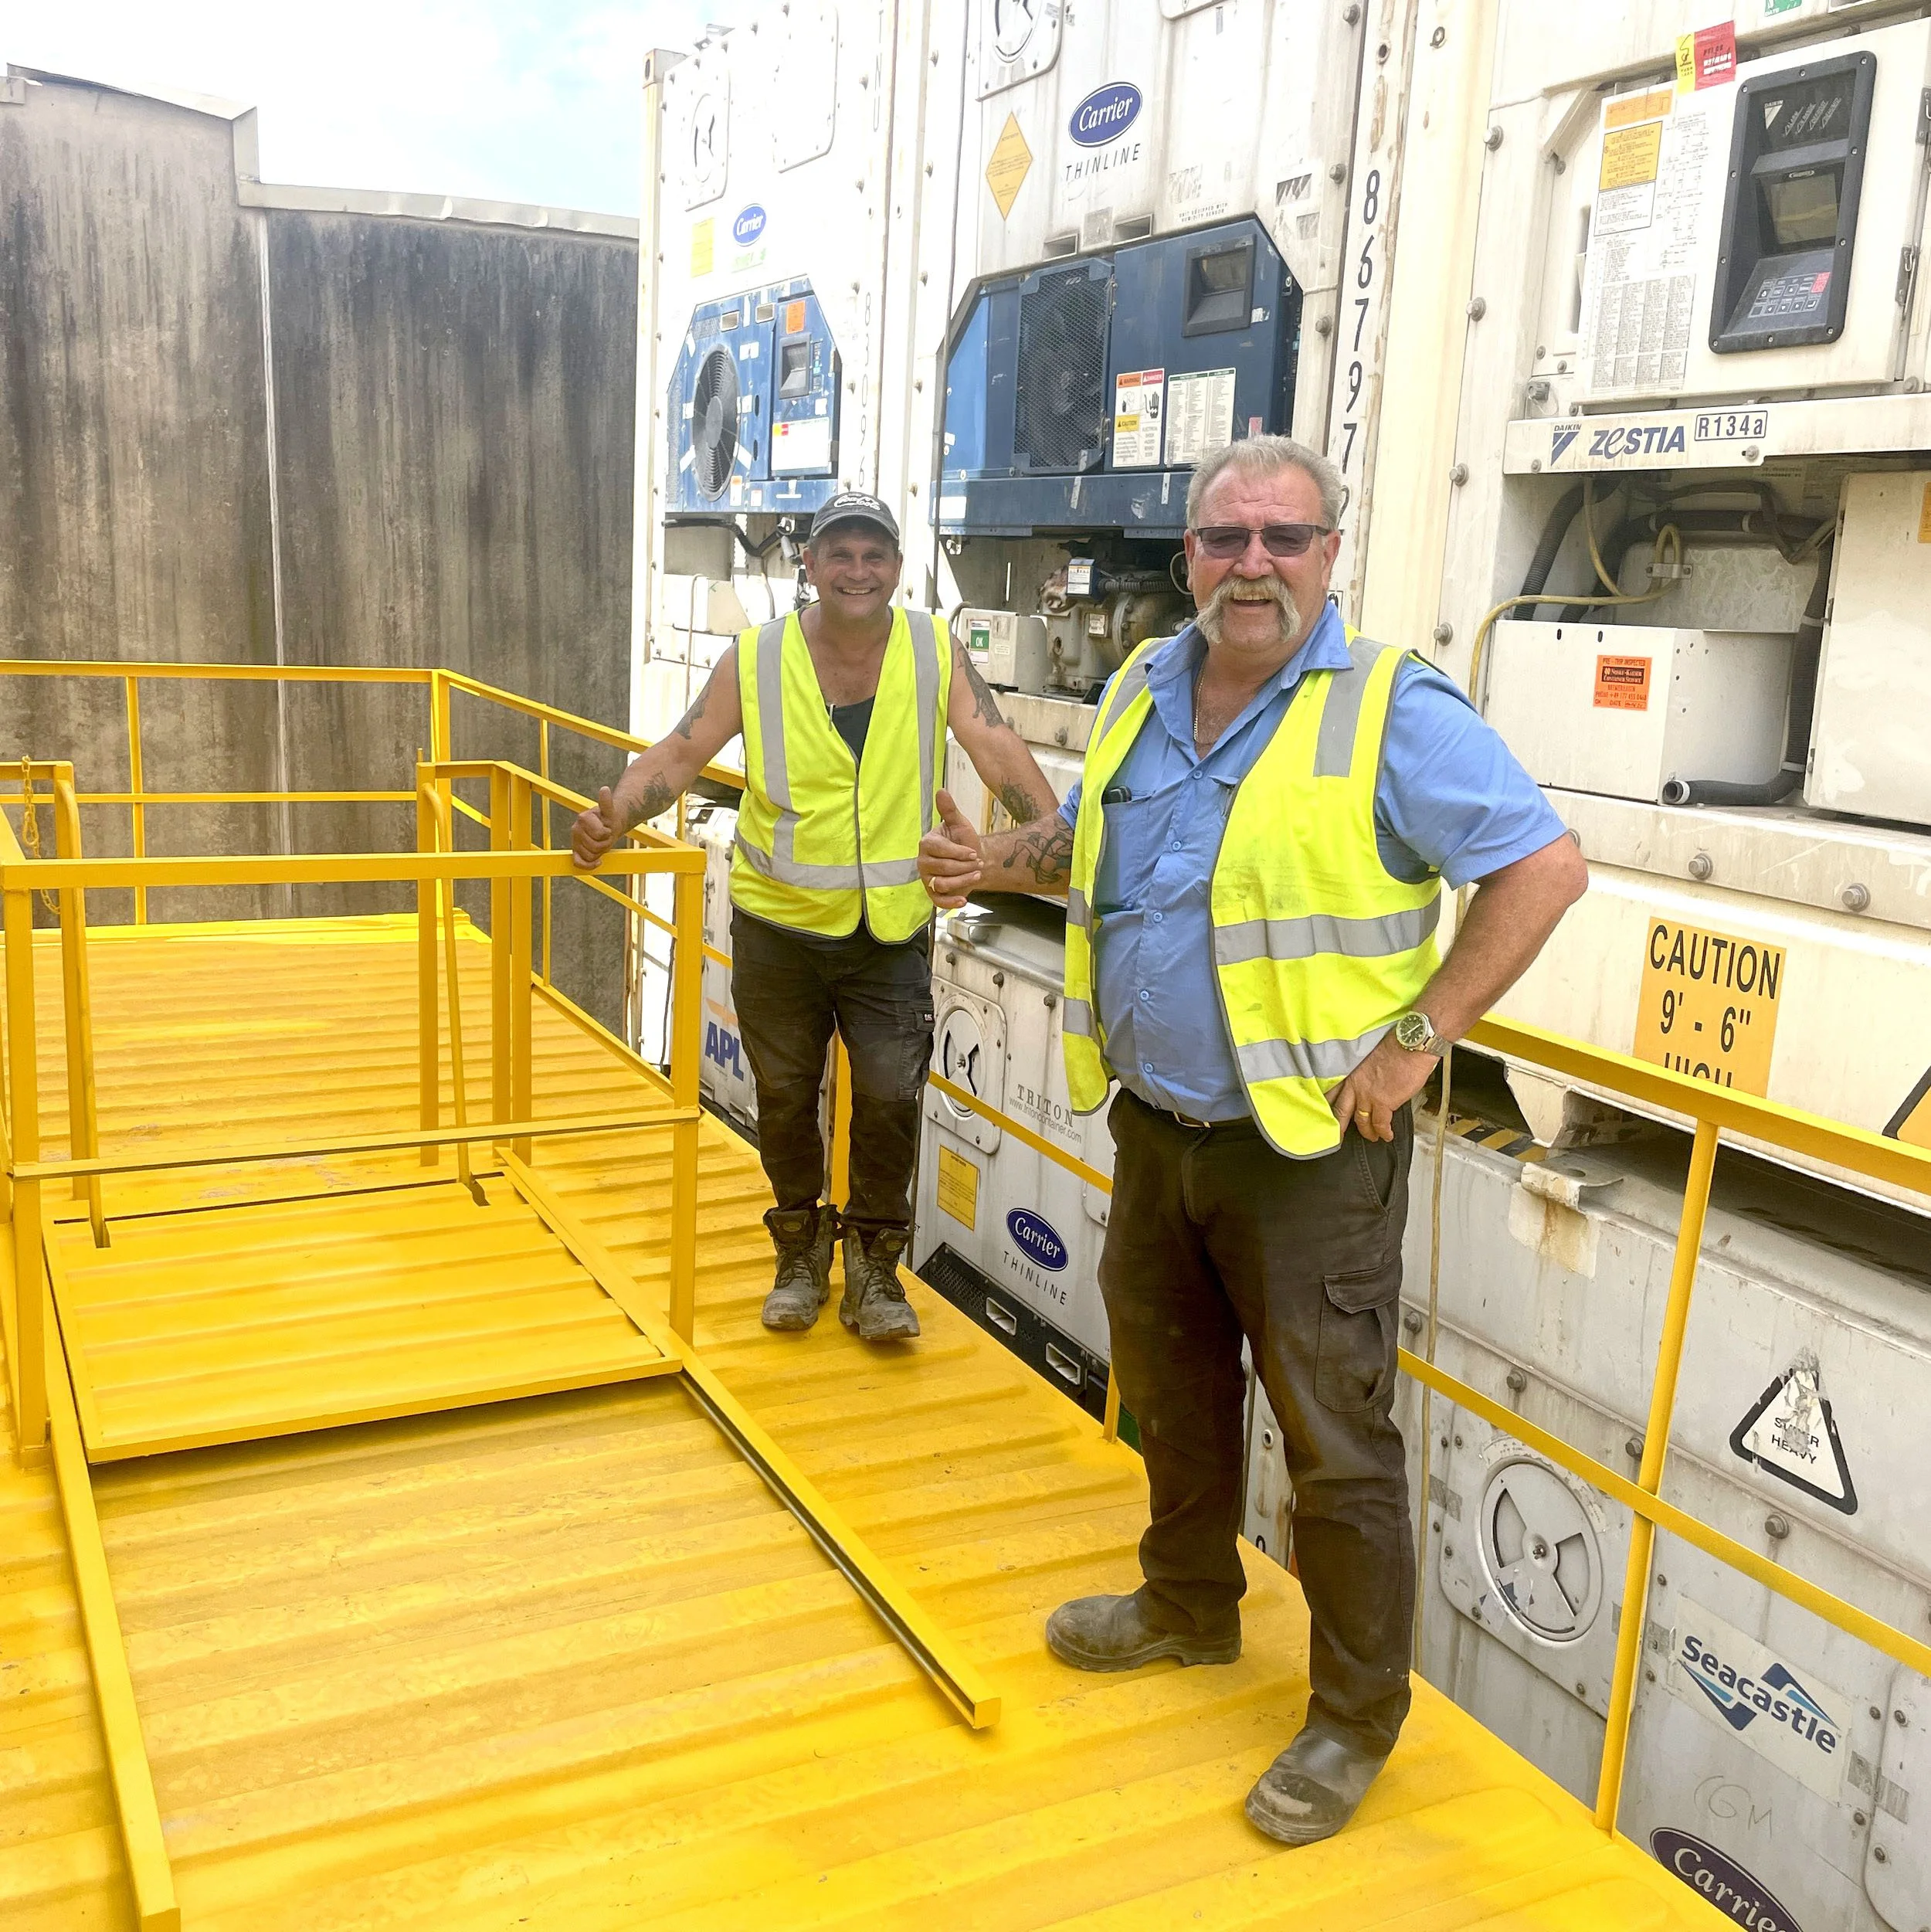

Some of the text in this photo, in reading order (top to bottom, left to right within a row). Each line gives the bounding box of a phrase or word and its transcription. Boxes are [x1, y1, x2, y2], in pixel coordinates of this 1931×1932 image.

[1079, 97, 1133, 132] Carrier
[1066, 143, 1141, 182] THINLINE
[736, 213, 764, 236] Carrier
[1554, 423, 1582, 432] DAIKIN
[1698, 416, 1763, 438] R134a
[975, 637, 983, 647] OK
[1650, 925, 1780, 1000] CAUTION
[705, 1021, 744, 1081] APL
[1017, 1084, 1073, 1128] TRITON
[1015, 1217, 1061, 1258] Carrier
[1003, 1251, 1067, 1306] THINLINE
[1682, 1635, 1836, 1754] Seacastle
[1674, 1848, 1787, 1932] Carrie
